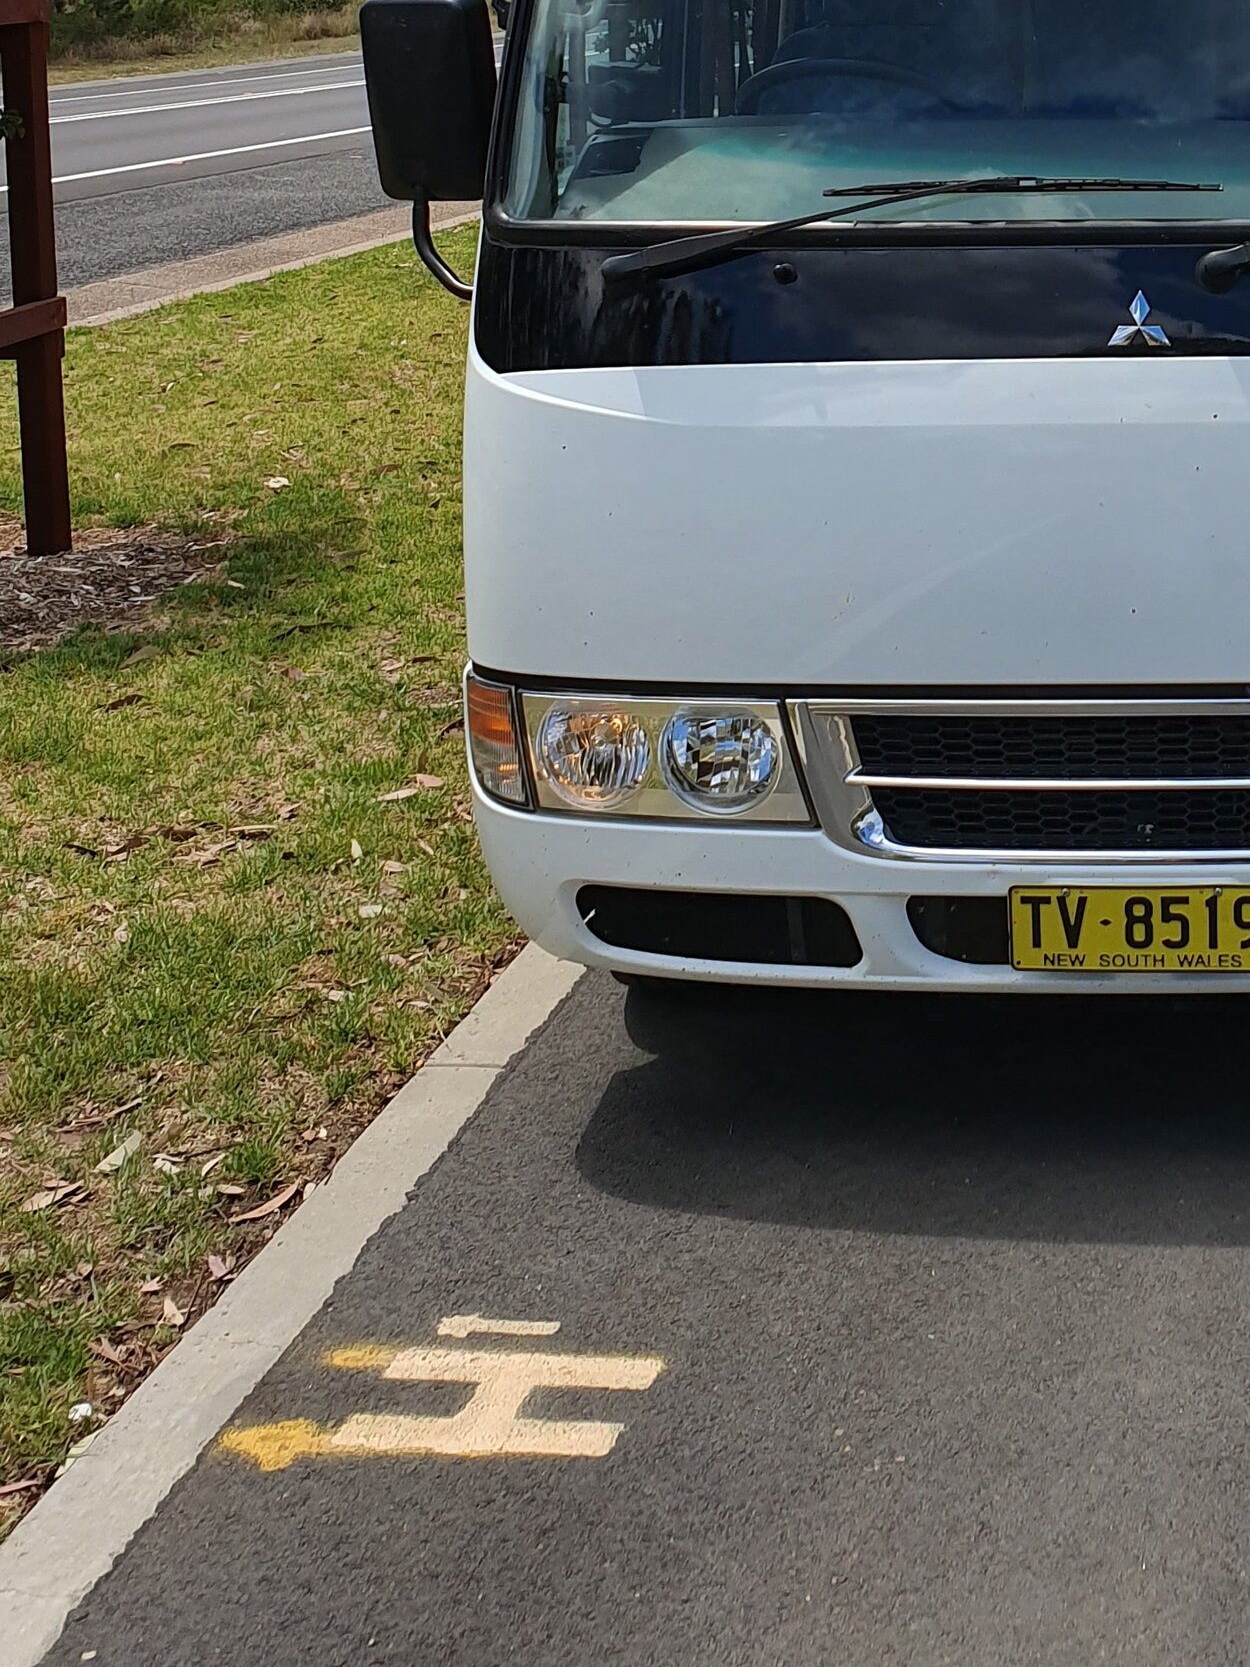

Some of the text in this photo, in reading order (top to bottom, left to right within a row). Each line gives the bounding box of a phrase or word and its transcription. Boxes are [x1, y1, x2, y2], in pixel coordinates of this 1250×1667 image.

[1042, 953, 1243, 968] NEW SOUTH WALES
